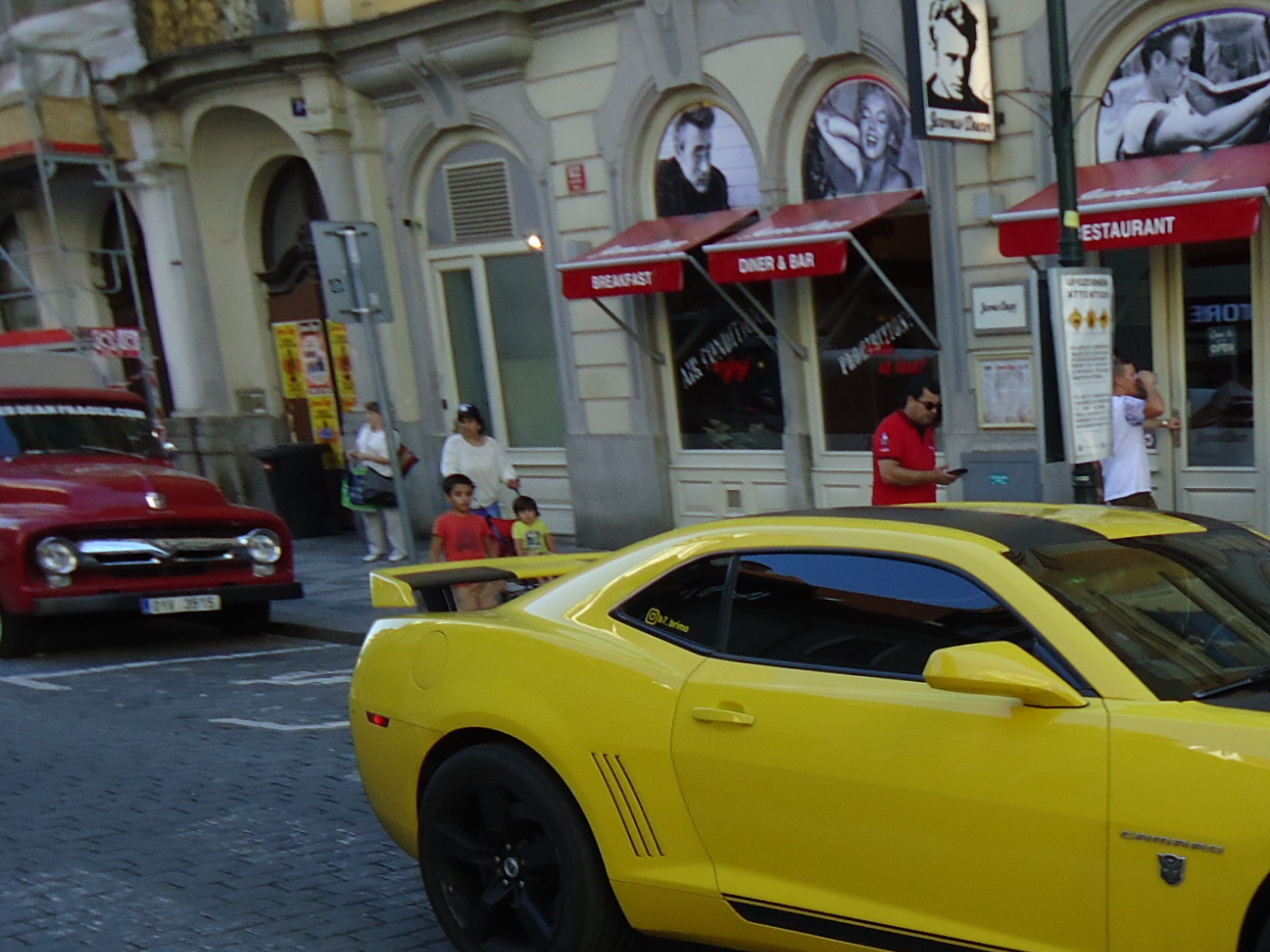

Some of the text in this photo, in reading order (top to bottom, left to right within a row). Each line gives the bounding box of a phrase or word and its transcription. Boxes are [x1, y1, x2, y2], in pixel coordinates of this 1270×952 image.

[1078, 216, 1176, 242] ESTAURANT
[738, 252, 816, 274] DINER & BAR
[590, 271, 653, 290] BREAKFAST
